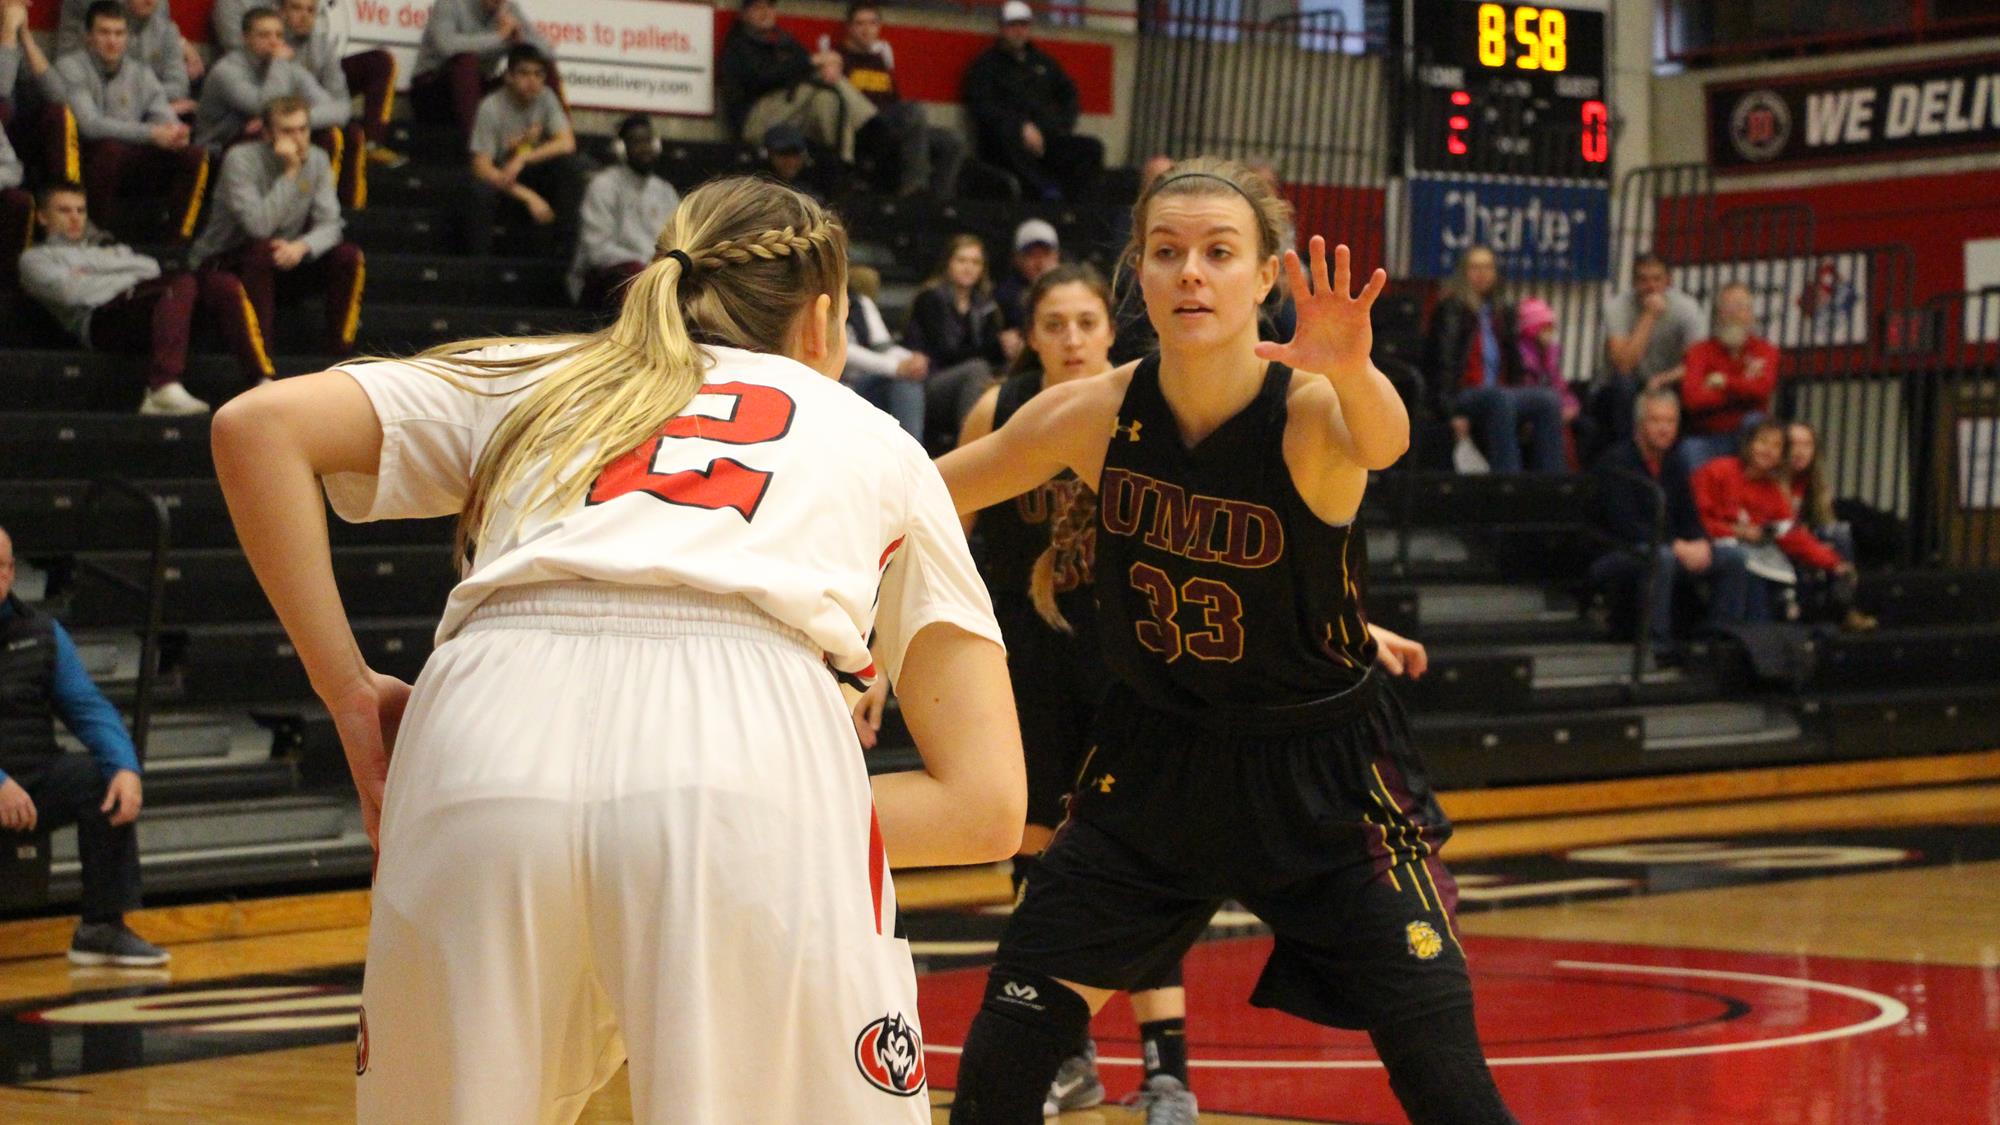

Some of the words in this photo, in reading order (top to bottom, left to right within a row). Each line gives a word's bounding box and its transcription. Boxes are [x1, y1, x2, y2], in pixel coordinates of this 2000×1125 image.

[356, 0, 390, 26] We
[593, 22, 616, 47] to
[1804, 87, 1877, 147] WE
[1884, 72, 2000, 140] DELI
[585, 380, 797, 524] 2
[1103, 466, 1285, 569] UMD
[1129, 561, 1245, 664] 33
